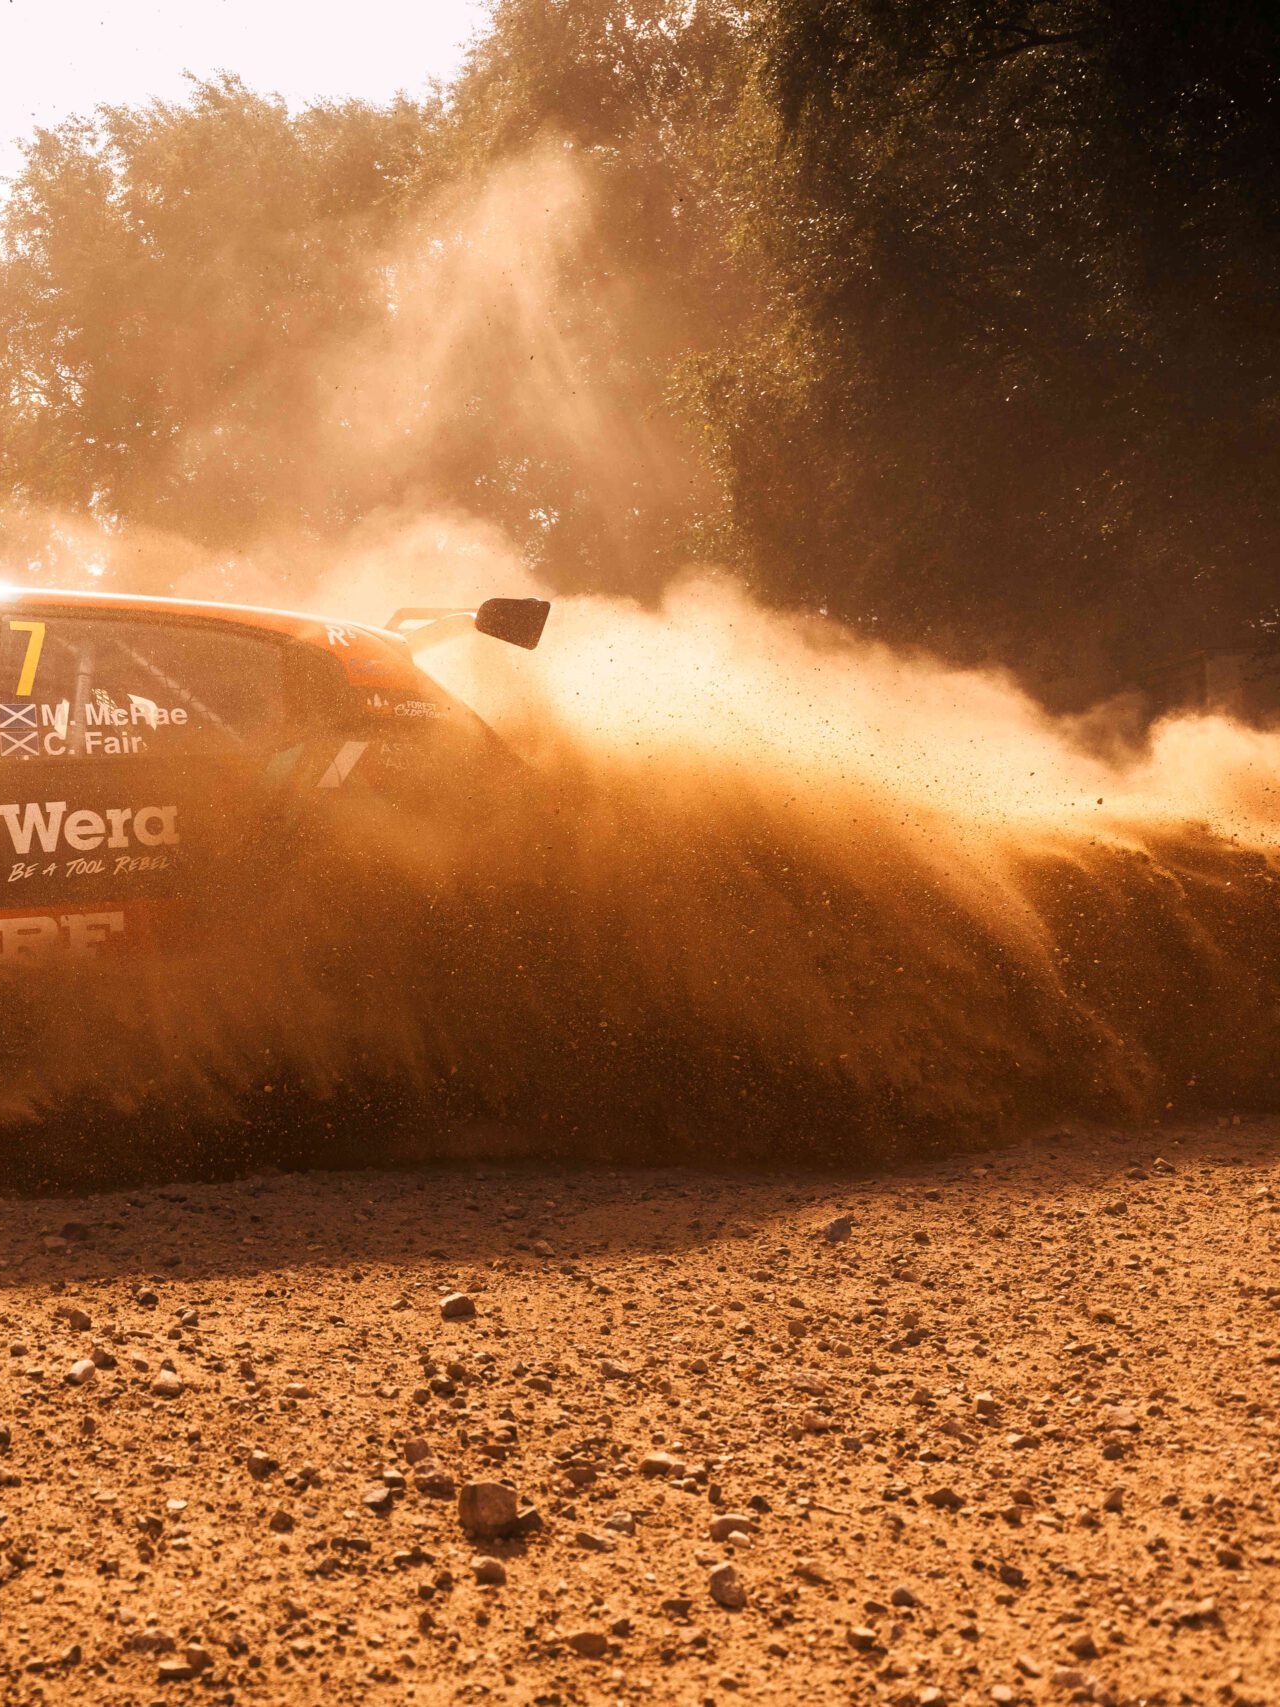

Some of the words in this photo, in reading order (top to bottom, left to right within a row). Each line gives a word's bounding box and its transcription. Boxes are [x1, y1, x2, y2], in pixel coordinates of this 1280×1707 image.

[9, 620, 46, 696] 7
[41, 703, 76, 726] M.
[84, 703, 188, 726] McRae
[43, 731, 76, 756] C.
[84, 731, 142, 755] Fair
[42, 862, 56, 877] A
[66, 858, 105, 878] TOOL
